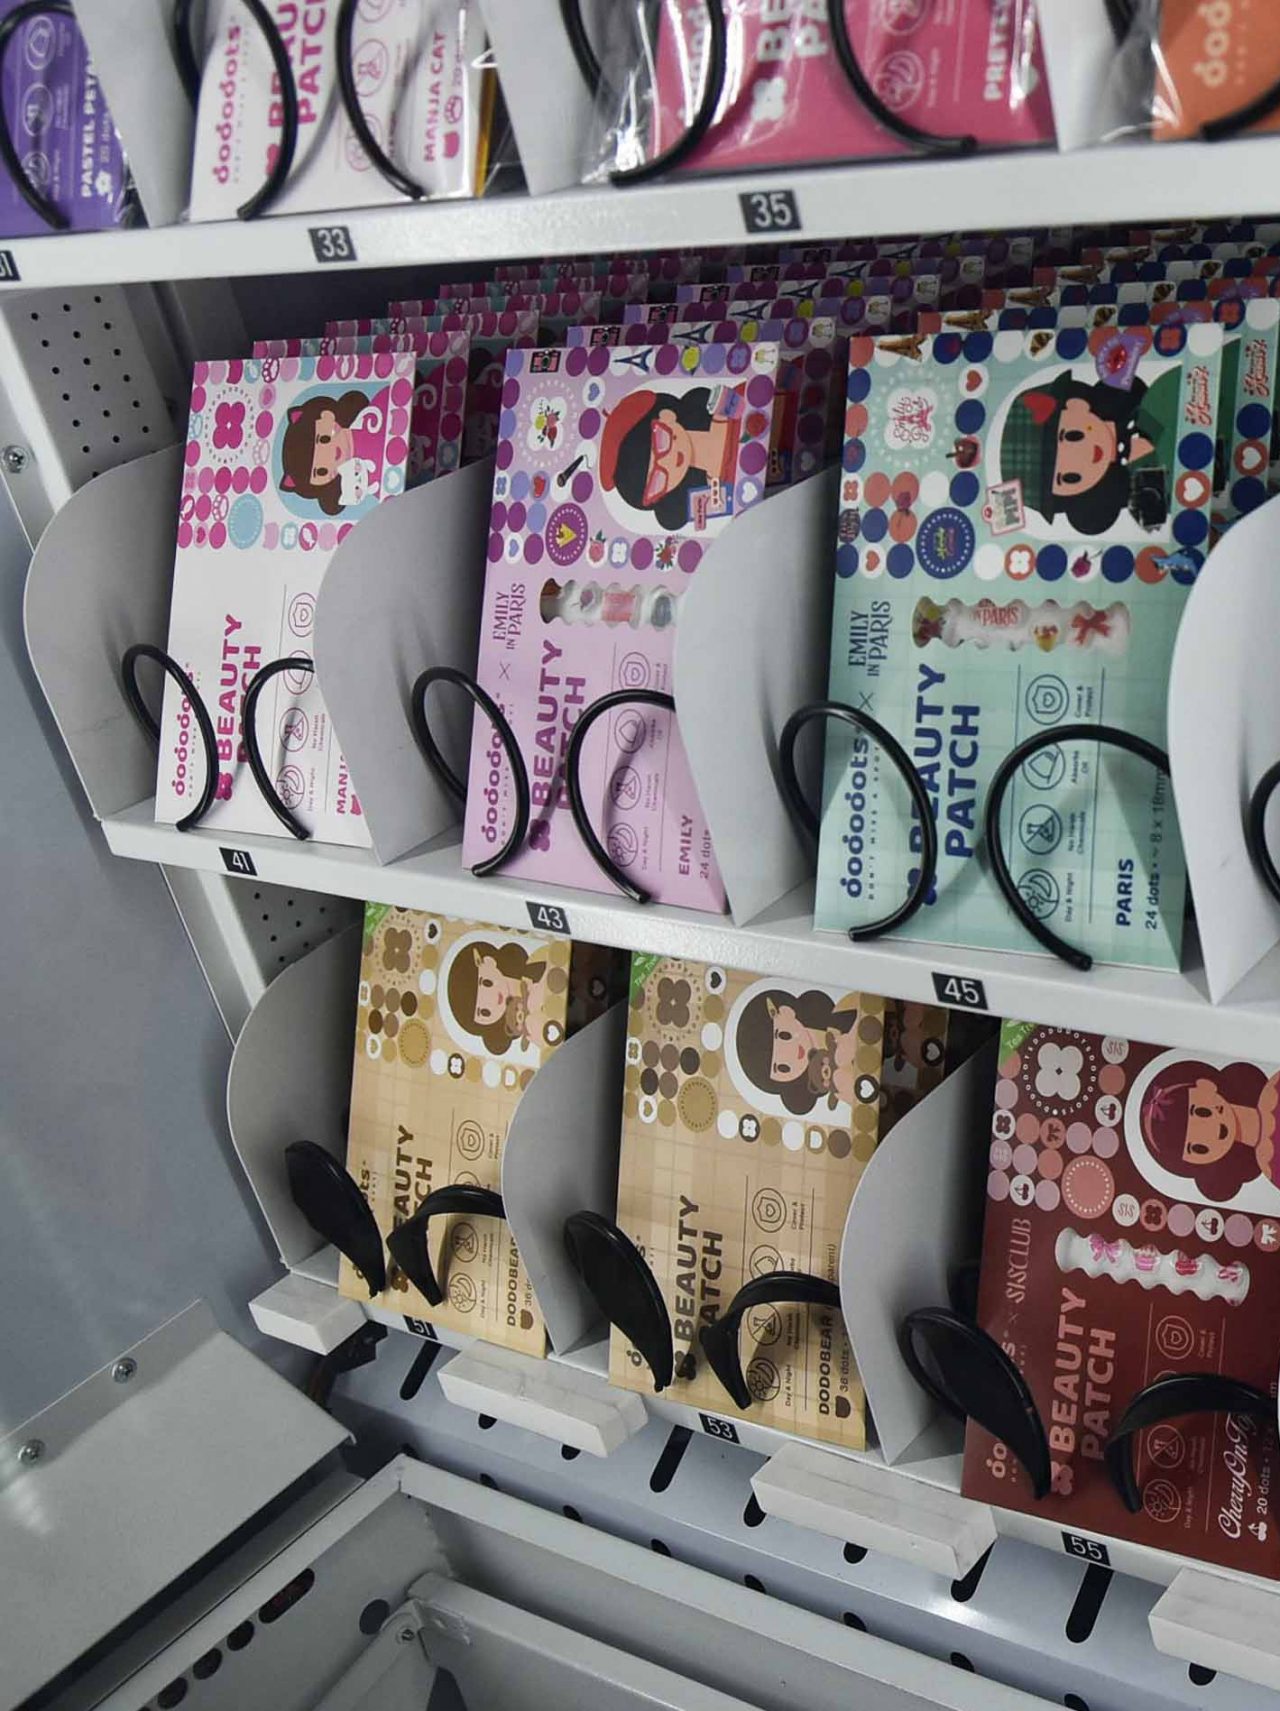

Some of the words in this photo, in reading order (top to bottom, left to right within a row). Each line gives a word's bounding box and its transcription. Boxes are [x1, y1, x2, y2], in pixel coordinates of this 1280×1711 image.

[297, 0, 325, 125] PATC
[430, 32, 447, 75] CAT
[213, 24, 241, 185] dododots
[752, 194, 793, 228] 35
[318, 229, 348, 258] 33
[493, 591, 509, 641] EMILY
[509, 576, 527, 636] PARIS
[870, 600, 893, 662] PARIS
[848, 609, 869, 668] EMILY
[216, 614, 242, 761] BEAUTY
[867, 663, 881, 678] IN
[531, 639, 562, 807] BEAUTY
[945, 705, 980, 858] PATCH
[678, 813, 693, 877] EMILY
[841, 737, 869, 898] dododots
[231, 851, 251, 872] 41
[1149, 873, 1160, 905] dots
[537, 907, 564, 929] 43
[1116, 857, 1135, 927] PARIS
[1145, 910, 1157, 930] 24
[943, 980, 981, 1004] 45
[1117, 1203, 1135, 1218] SIS
[674, 1195, 699, 1342] BEAUTY
[1006, 1218, 1032, 1304] SISCLUB
[818, 1314, 833, 1417] DODOBEAR
[1049, 1287, 1086, 1453] BEAUTY
[1080, 1328, 1116, 1460] PATCH
[706, 1421, 733, 1438] 53
[1255, 1497, 1268, 1515] 20
[1071, 1536, 1101, 1561] 55
